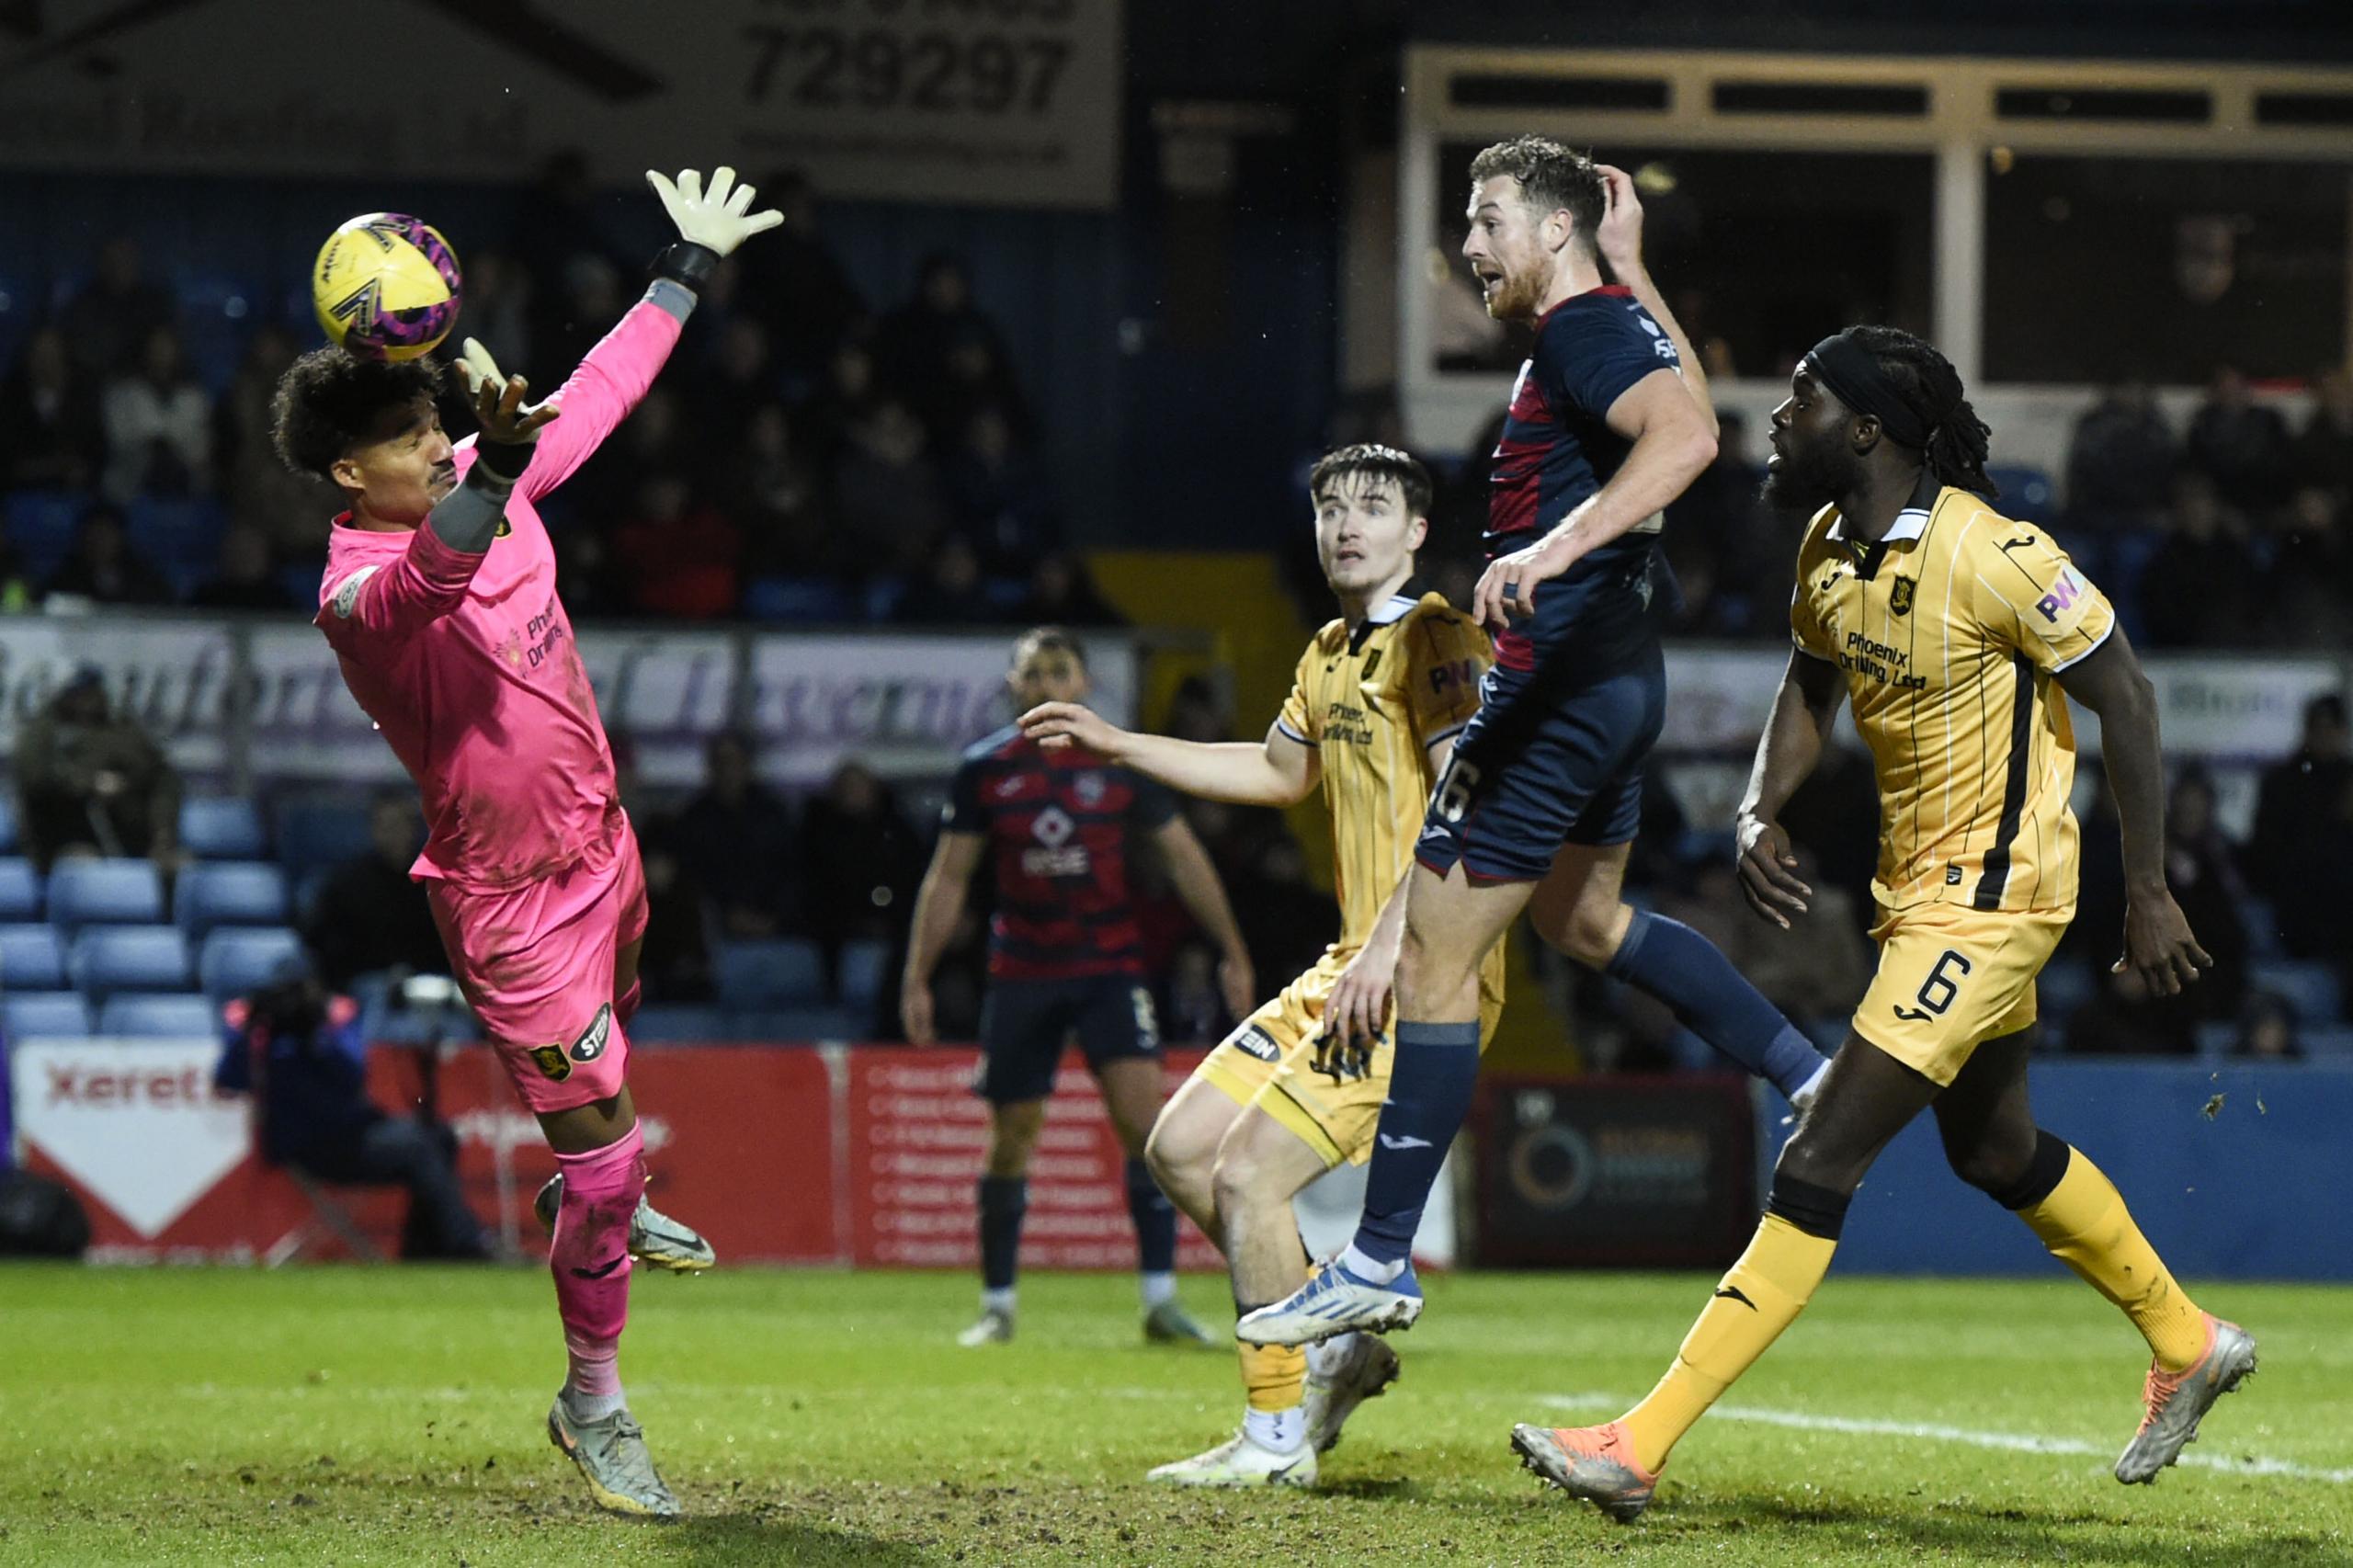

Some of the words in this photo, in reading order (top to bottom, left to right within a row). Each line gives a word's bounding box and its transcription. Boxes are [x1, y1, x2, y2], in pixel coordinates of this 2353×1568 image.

[740, 25, 1074, 112] 729297
[2035, 569, 2078, 623] PW
[1839, 652, 1886, 683] Drilling
[1893, 668, 1927, 691] Ltd
[1847, 631, 1908, 667] Phoenix
[1915, 948, 1972, 1016] 6
